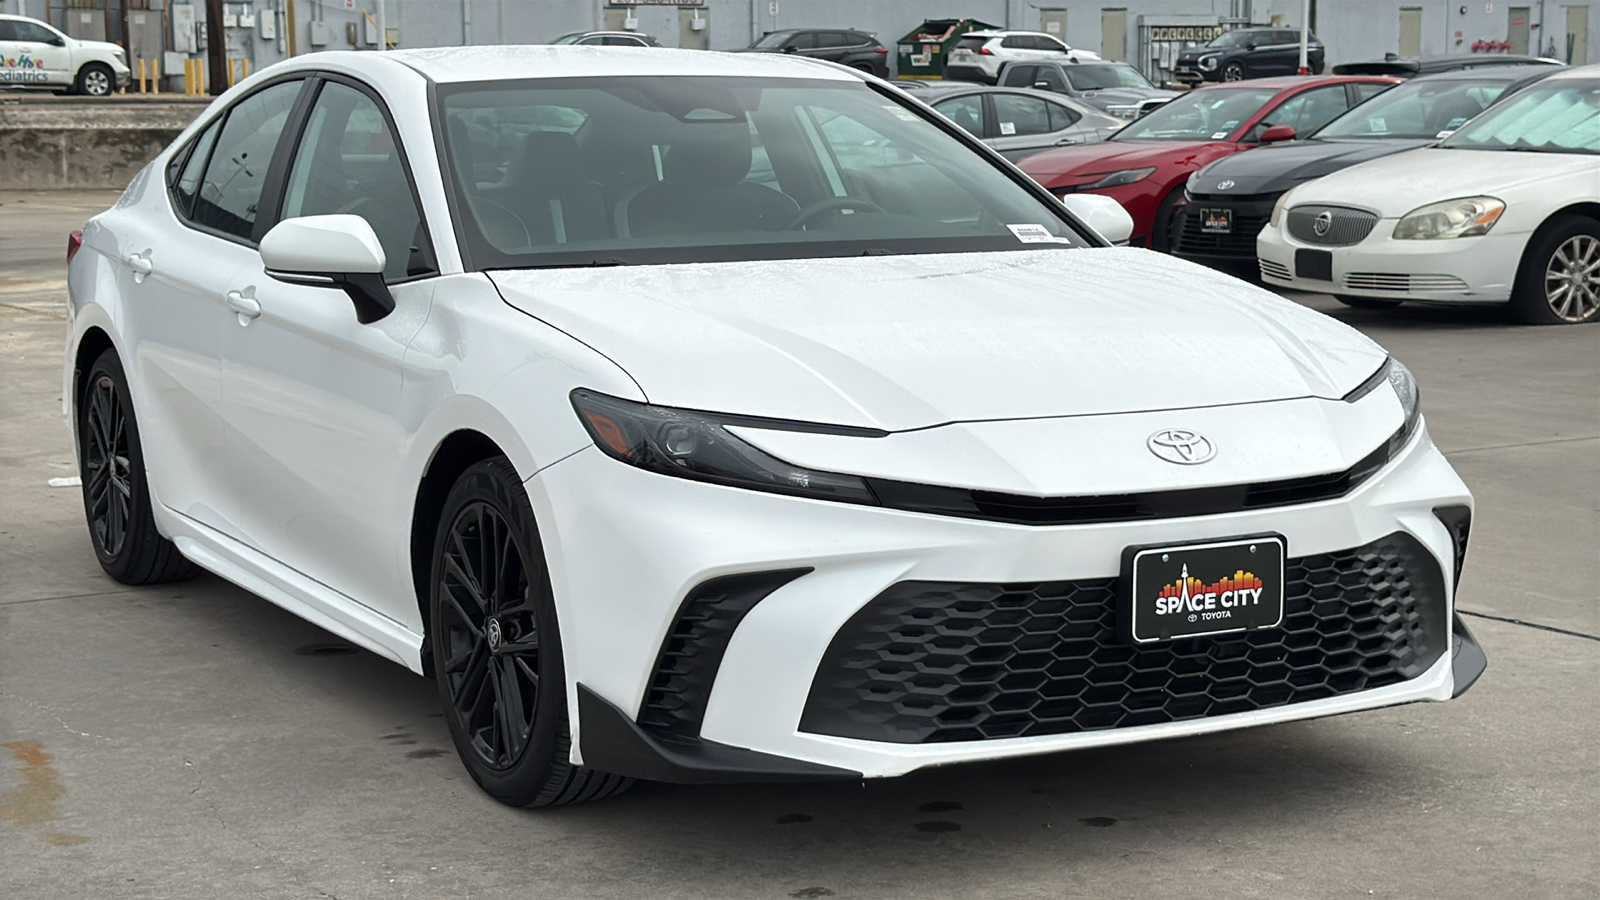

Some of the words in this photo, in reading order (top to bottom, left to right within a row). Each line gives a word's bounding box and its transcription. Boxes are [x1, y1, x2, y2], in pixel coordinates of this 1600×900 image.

[1155, 578, 1216, 615] SPACE
[1220, 587, 1263, 608] CITY
[1201, 611, 1232, 620] TOYOTA
